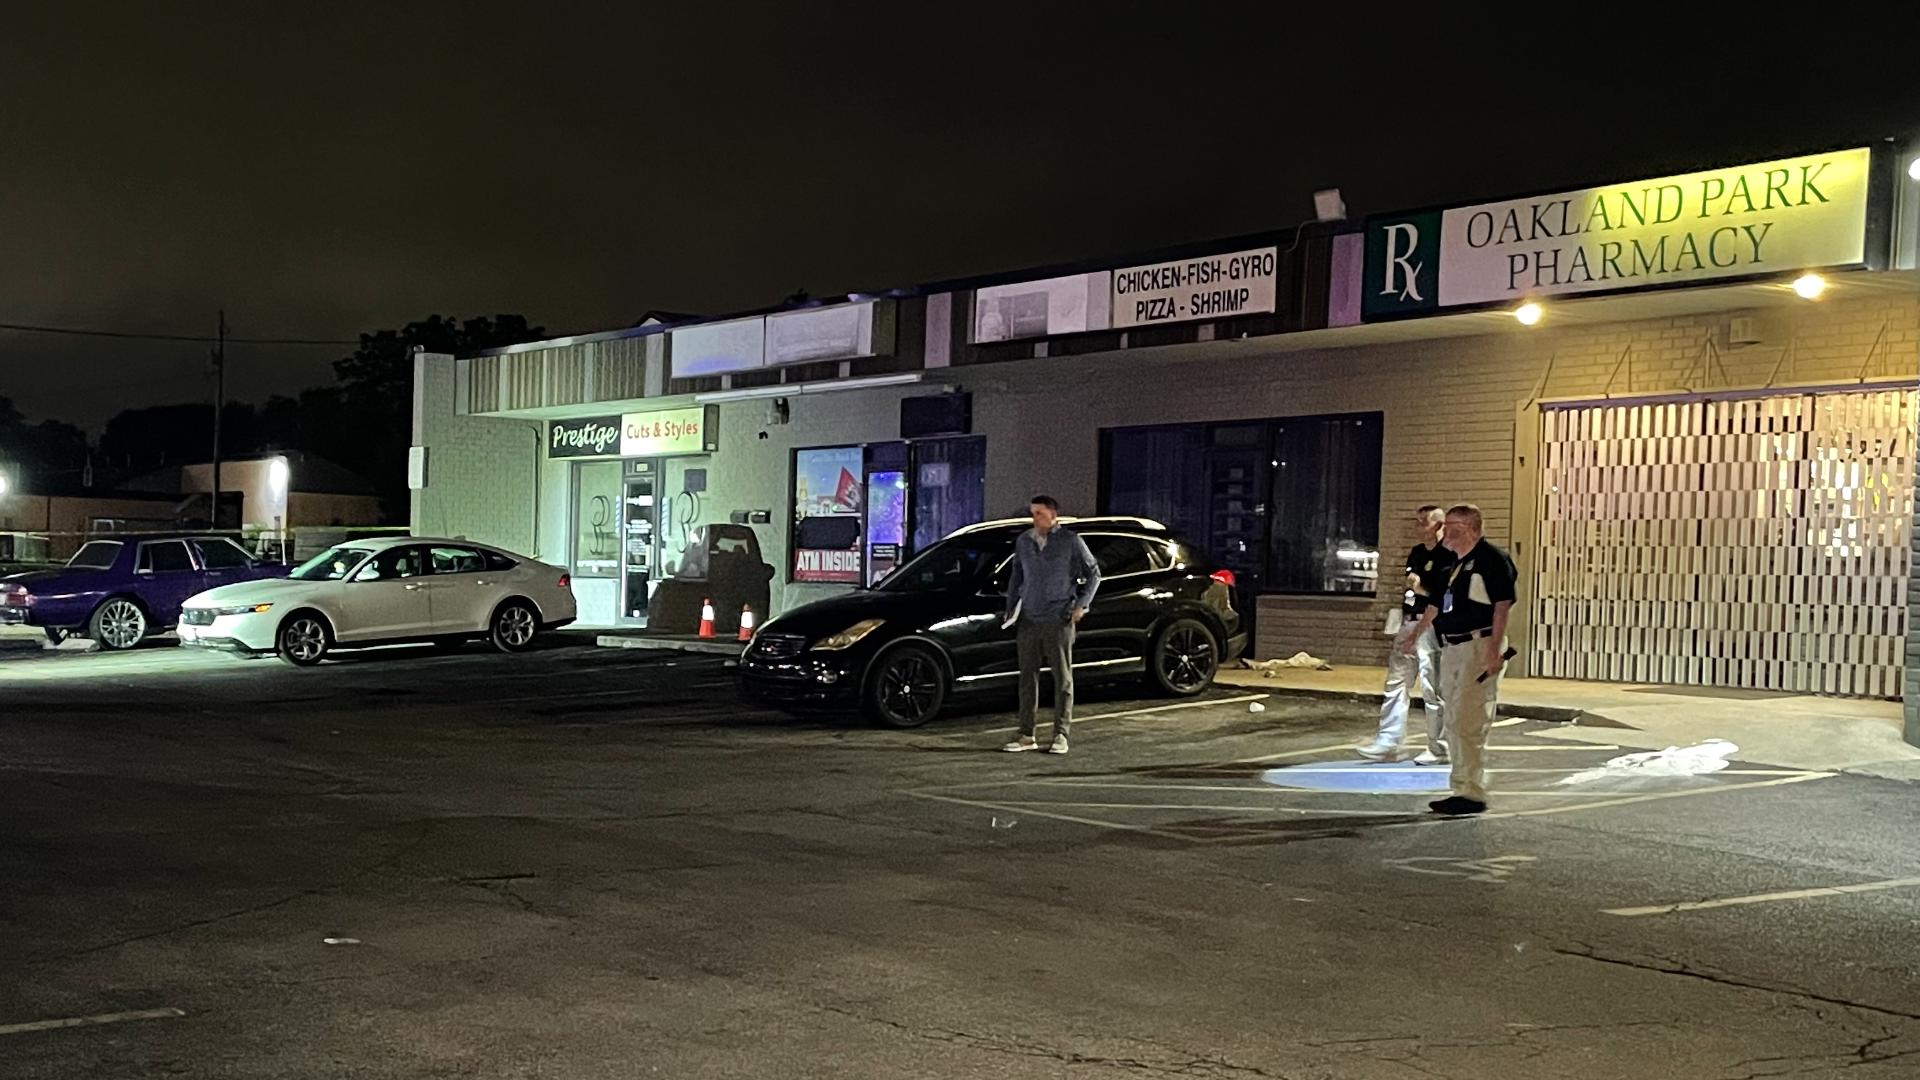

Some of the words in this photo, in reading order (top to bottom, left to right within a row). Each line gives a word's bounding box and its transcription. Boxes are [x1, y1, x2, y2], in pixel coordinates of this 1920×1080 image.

[1467, 183, 1683, 248] OAKLAND
[1697, 163, 1831, 218] PARK
[1117, 253, 1274, 294] CHICKEN-FISH-GYRO
[1507, 222, 1773, 290] PHARMACY
[1136, 297, 1176, 322] PIZZA
[1190, 287, 1250, 317] SHRIMP
[552, 422, 619, 453] Prestige
[626, 423, 650, 439] Cuts
[653, 422, 662, 438] &
[664, 418, 699, 441] Styles
[796, 551, 820, 571] ATM
[821, 551, 861, 572] INSIDE
